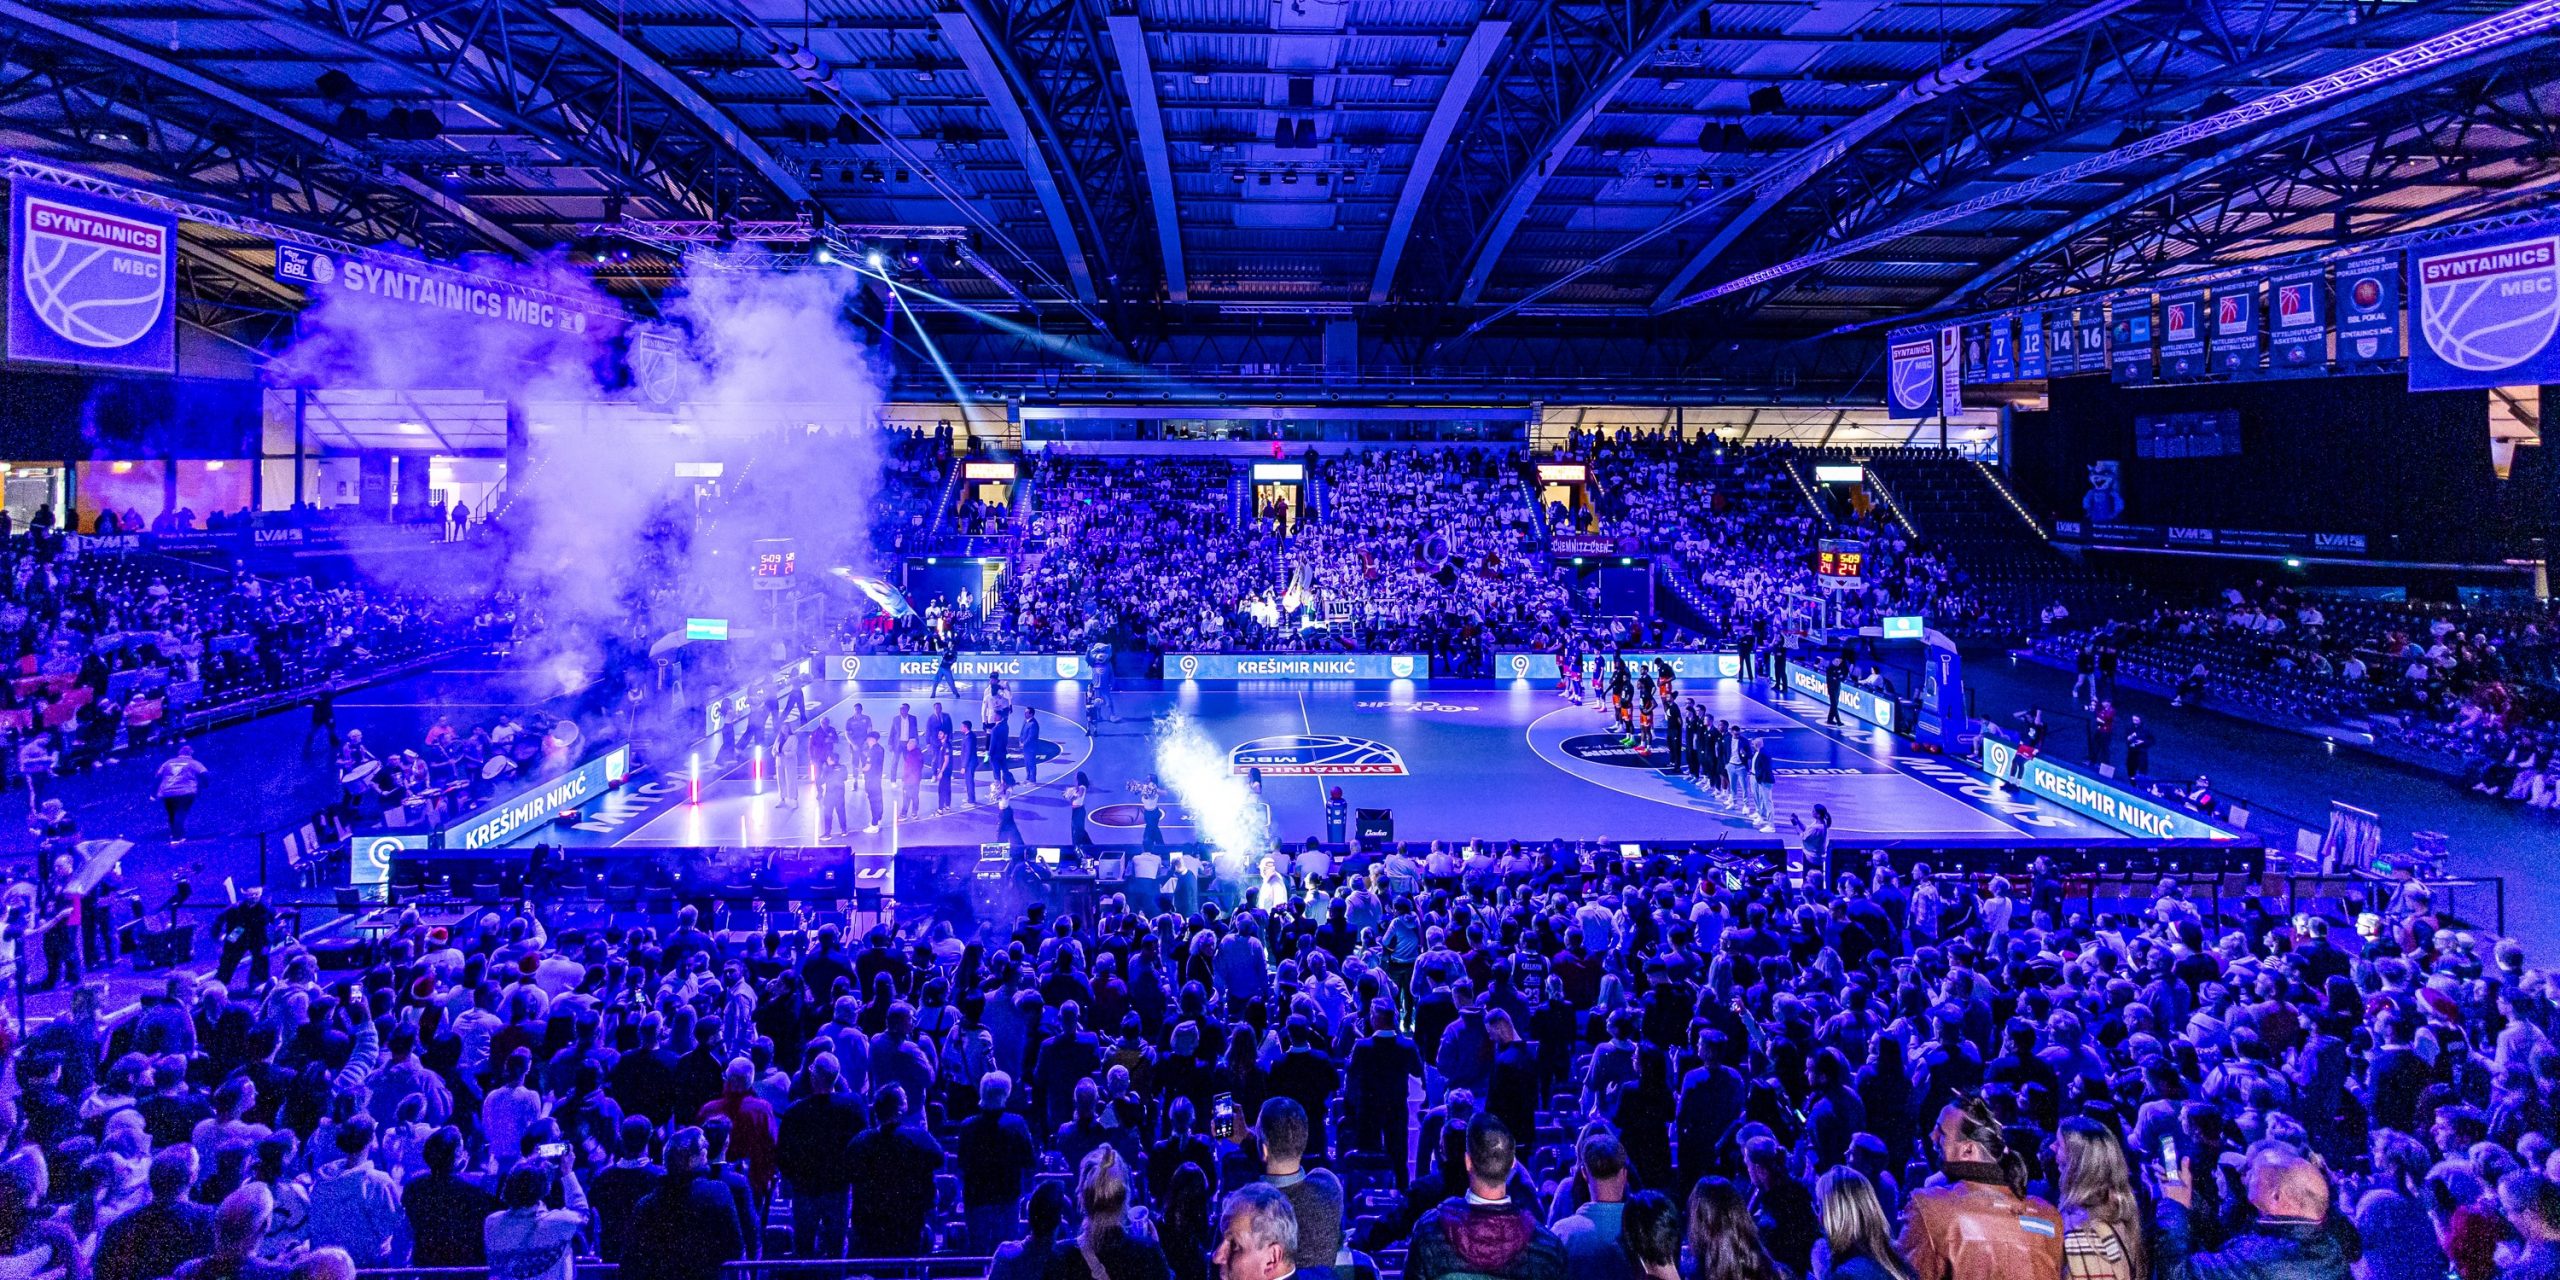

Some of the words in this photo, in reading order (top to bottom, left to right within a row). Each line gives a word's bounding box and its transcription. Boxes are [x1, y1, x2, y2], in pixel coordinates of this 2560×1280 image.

[35, 210, 158, 249] SYNTAINICS
[112, 257, 158, 278] MBC
[283, 261, 308, 277] BBL
[2347, 257, 2386, 269] DEUTSCHER
[2427, 247, 2550, 279] SYNTAINICS
[344, 261, 501, 317] SYNTAINICS
[507, 297, 554, 328] MBC
[2501, 278, 2553, 297] MBC
[2362, 313, 2386, 321] POKAL
[1996, 337, 2005, 357] 7
[2024, 333, 2040, 354] 12
[2053, 330, 2071, 351] 14
[2082, 327, 2101, 348] 16
[1893, 344, 1931, 358] SYNTAINICS
[82, 535, 121, 549] LVM
[255, 529, 289, 542] LVM
[2169, 527, 2199, 539] LVM
[2315, 533, 2350, 546] LVM
[758, 563, 778, 576] 24
[1820, 561, 1831, 574] 24
[1838, 563, 1857, 575] 24
[842, 656, 861, 680] 9
[900, 658, 973, 674] KREŠMIR
[977, 658, 1020, 674] NIKIĆ
[1180, 656, 1198, 679] 9
[1237, 658, 1310, 674] KREŠIMIR
[1313, 658, 1355, 674] NIKIĆ
[1511, 655, 1530, 679] 9
[1795, 671, 1829, 697] KREŠIM
[1239, 765, 1396, 773] SYNTAINICS
[1990, 743, 2009, 779] 9
[2034, 768, 2116, 821] KREŠIMIR
[2118, 802, 2175, 839] NIKIĆ
[466, 797, 544, 850] KREŠIMIR
[547, 771, 587, 808] NIKIĆ
